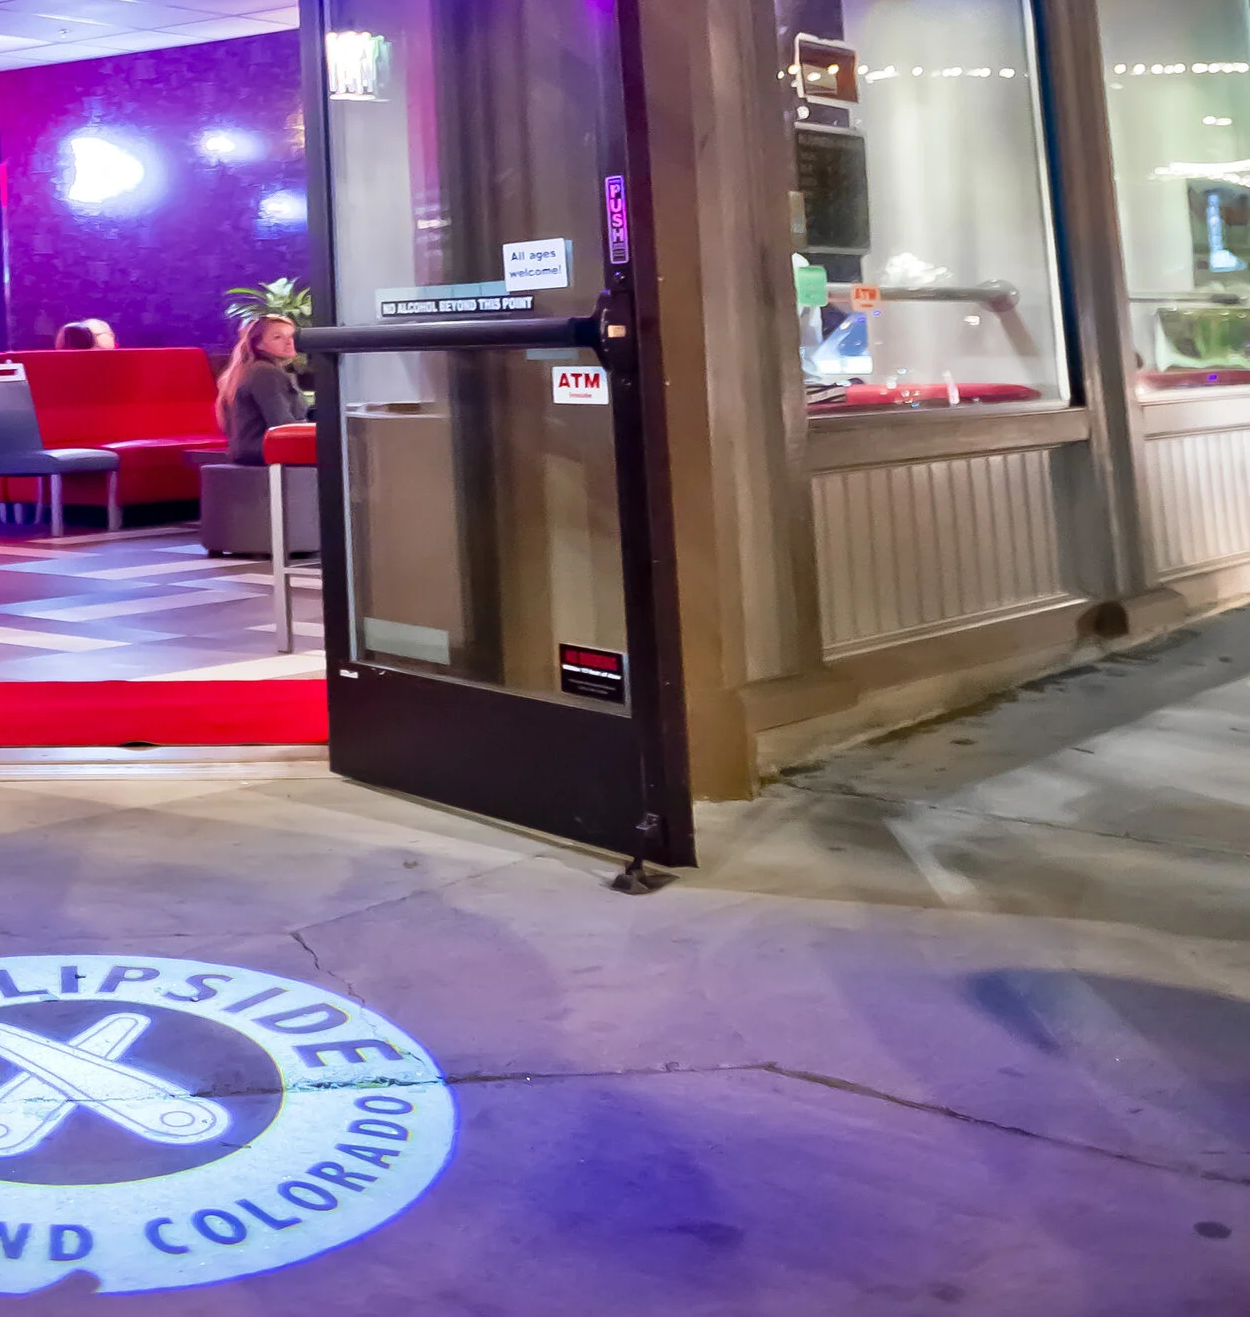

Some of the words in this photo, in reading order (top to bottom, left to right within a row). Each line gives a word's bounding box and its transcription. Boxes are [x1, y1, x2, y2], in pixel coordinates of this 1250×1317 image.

[609, 184, 624, 243] PUSH
[511, 252, 525, 261] All
[529, 250, 556, 262] ages
[509, 265, 562, 278] welcome!
[382, 303, 396, 314] NO
[397, 301, 438, 313] ALCOHOL
[439, 299, 477, 312] BEYOND
[478, 298, 500, 310] THIS
[502, 297, 533, 310] POINT
[558, 373, 600, 388] ATM
[145, 1094, 415, 1255] COLORADO
